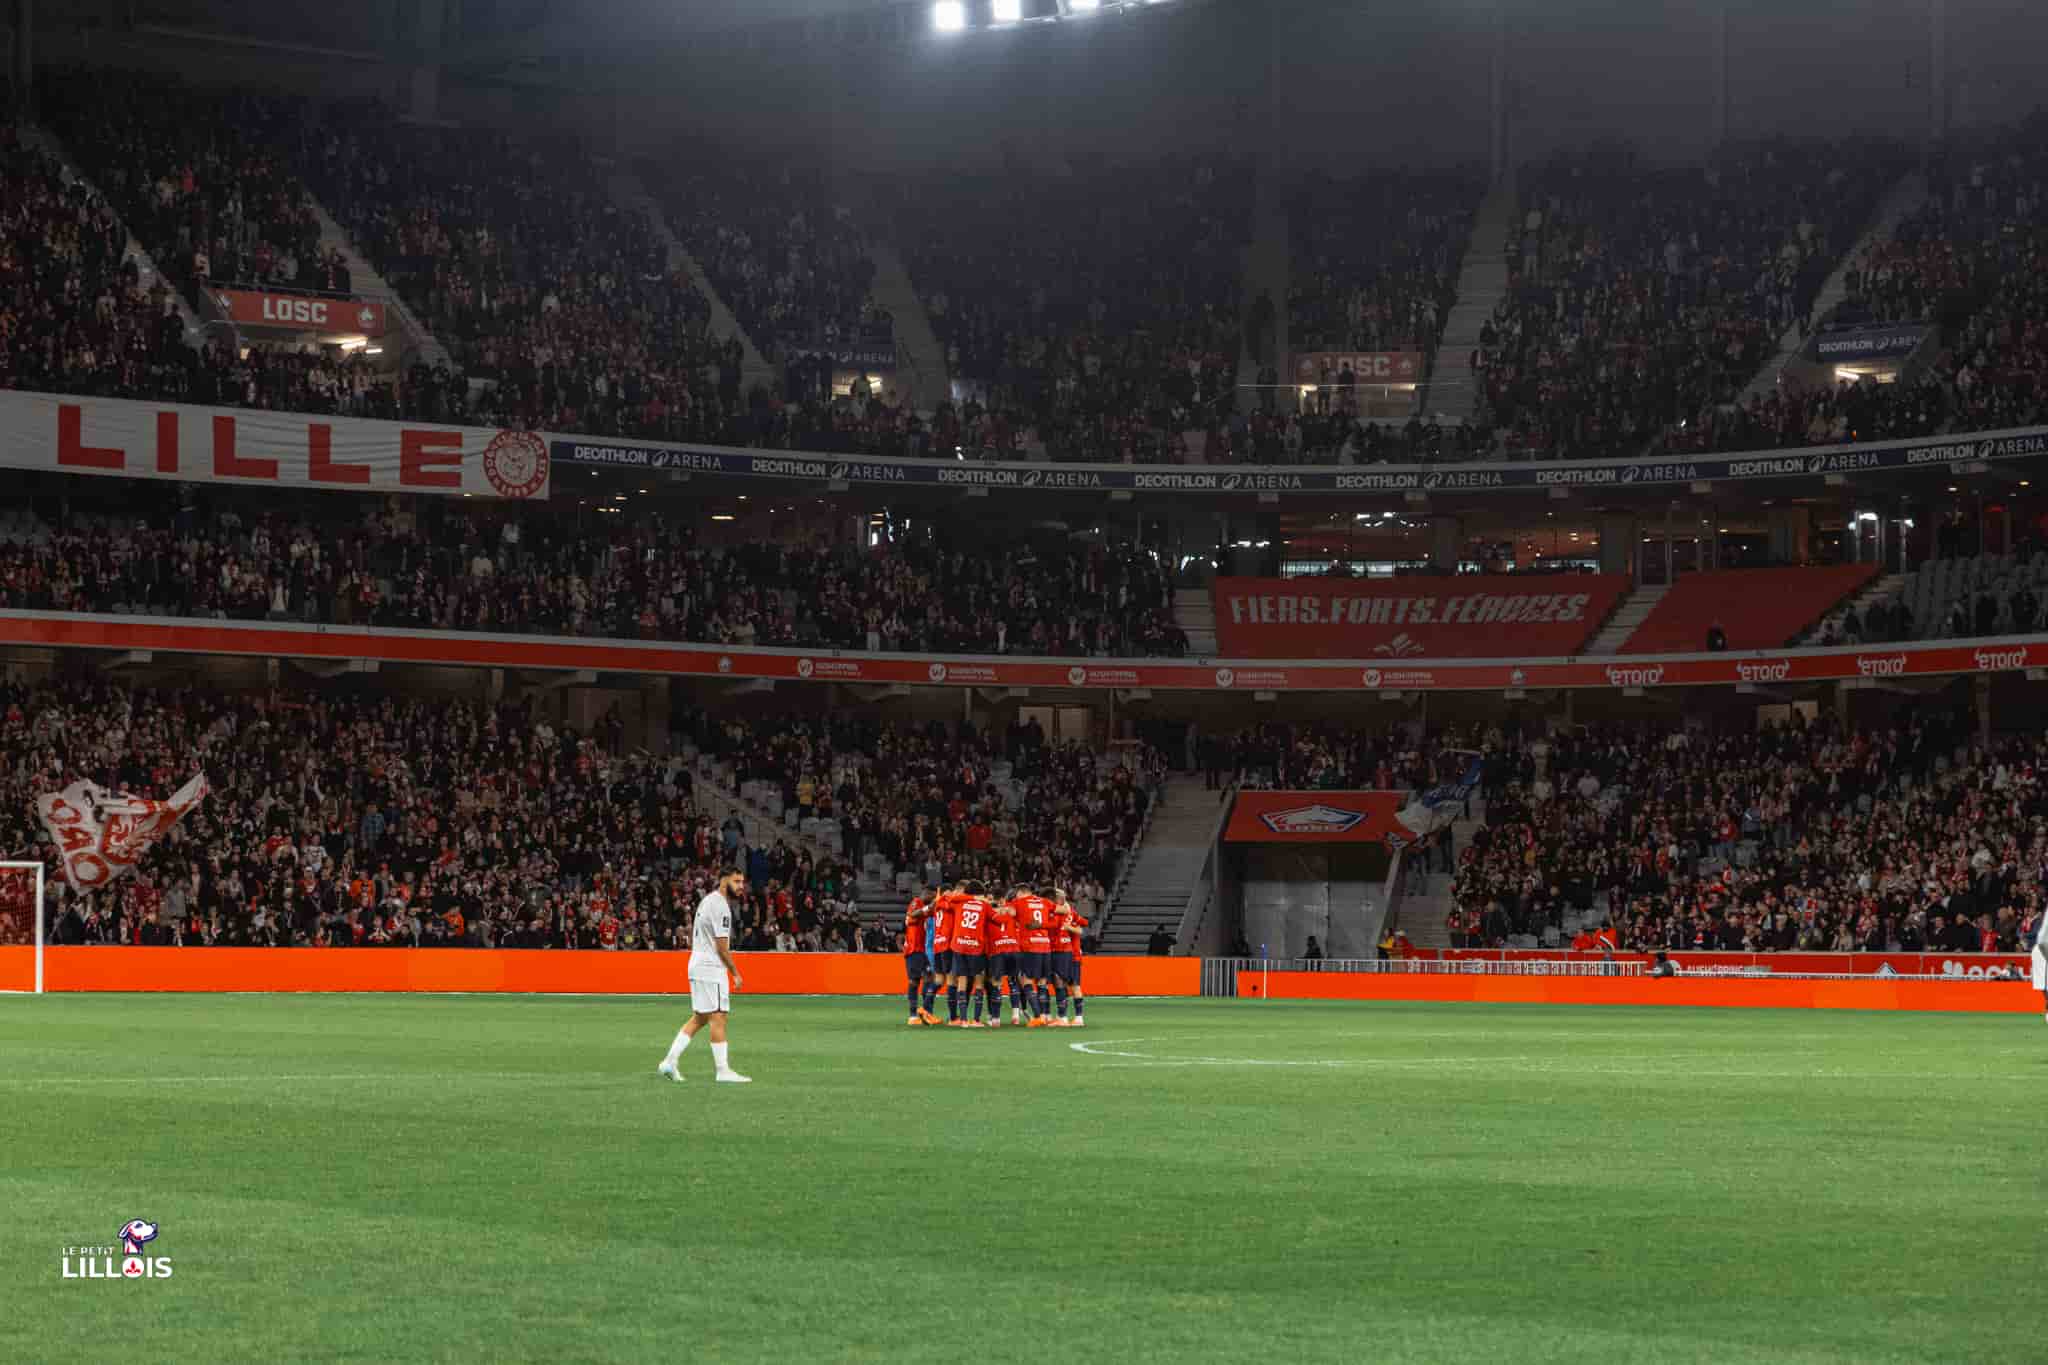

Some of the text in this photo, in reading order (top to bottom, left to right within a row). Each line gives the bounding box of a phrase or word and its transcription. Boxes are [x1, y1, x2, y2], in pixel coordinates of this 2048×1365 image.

[263, 297, 328, 323] LOSC
[57, 404, 463, 488] LILLE
[1907, 435, 2047, 463] DECATHLON ARENA
[574, 446, 722, 470] DECATHLON ARENA
[1728, 454, 1880, 477] DECATHLON ARENA
[752, 460, 905, 481] DECATHLON ARENA
[938, 469, 1101, 487] DECATHLON ARENA
[1336, 472, 1502, 489] DECATHLON ARENA
[1536, 464, 1697, 485] DECATHLON ARENA
[1135, 474, 1302, 490] DECATHLON ARENA
[961, 911, 980, 929] 32
